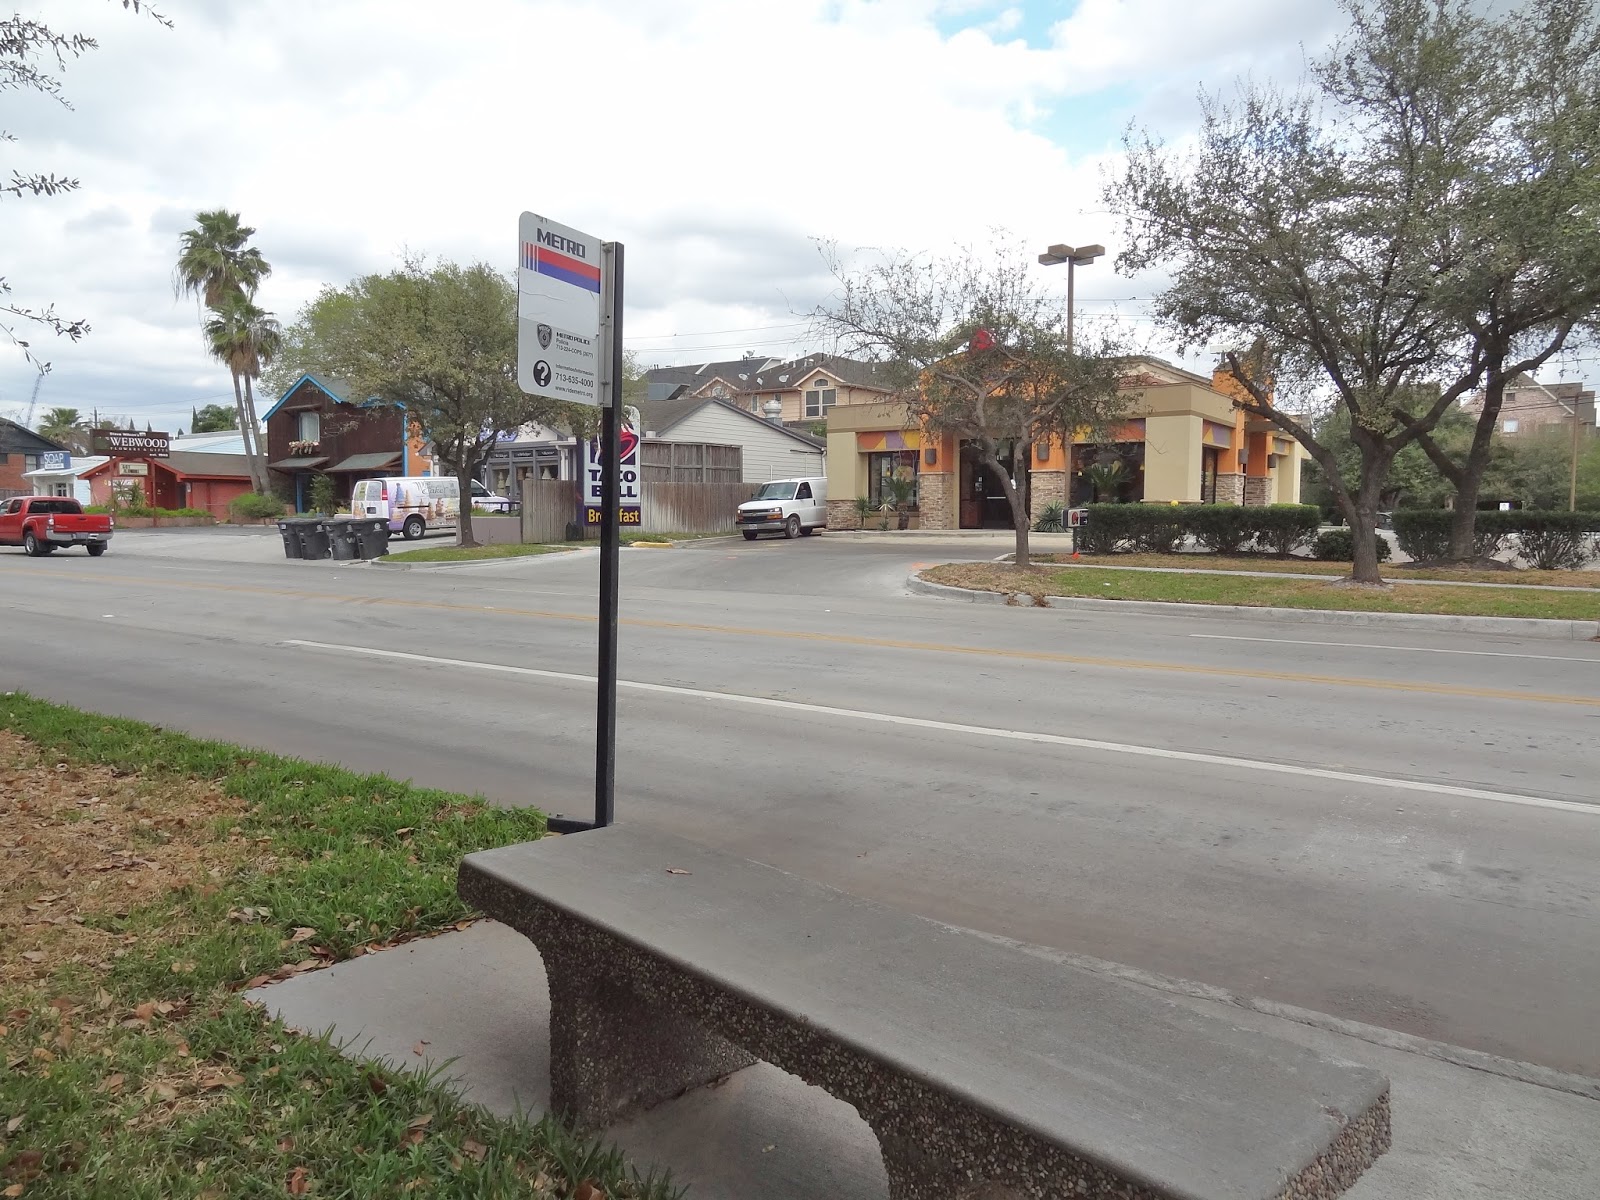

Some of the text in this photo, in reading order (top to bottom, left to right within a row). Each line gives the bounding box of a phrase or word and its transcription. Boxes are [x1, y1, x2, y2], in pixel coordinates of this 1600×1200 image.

[536, 227, 586, 259] METRO
[555, 372, 594, 388] 713-635-4000
[110, 436, 168, 448] WEBWOOD
[44, 452, 64, 464] SOAP
[587, 469, 637, 483] TO
[588, 508, 640, 523] Brfast
